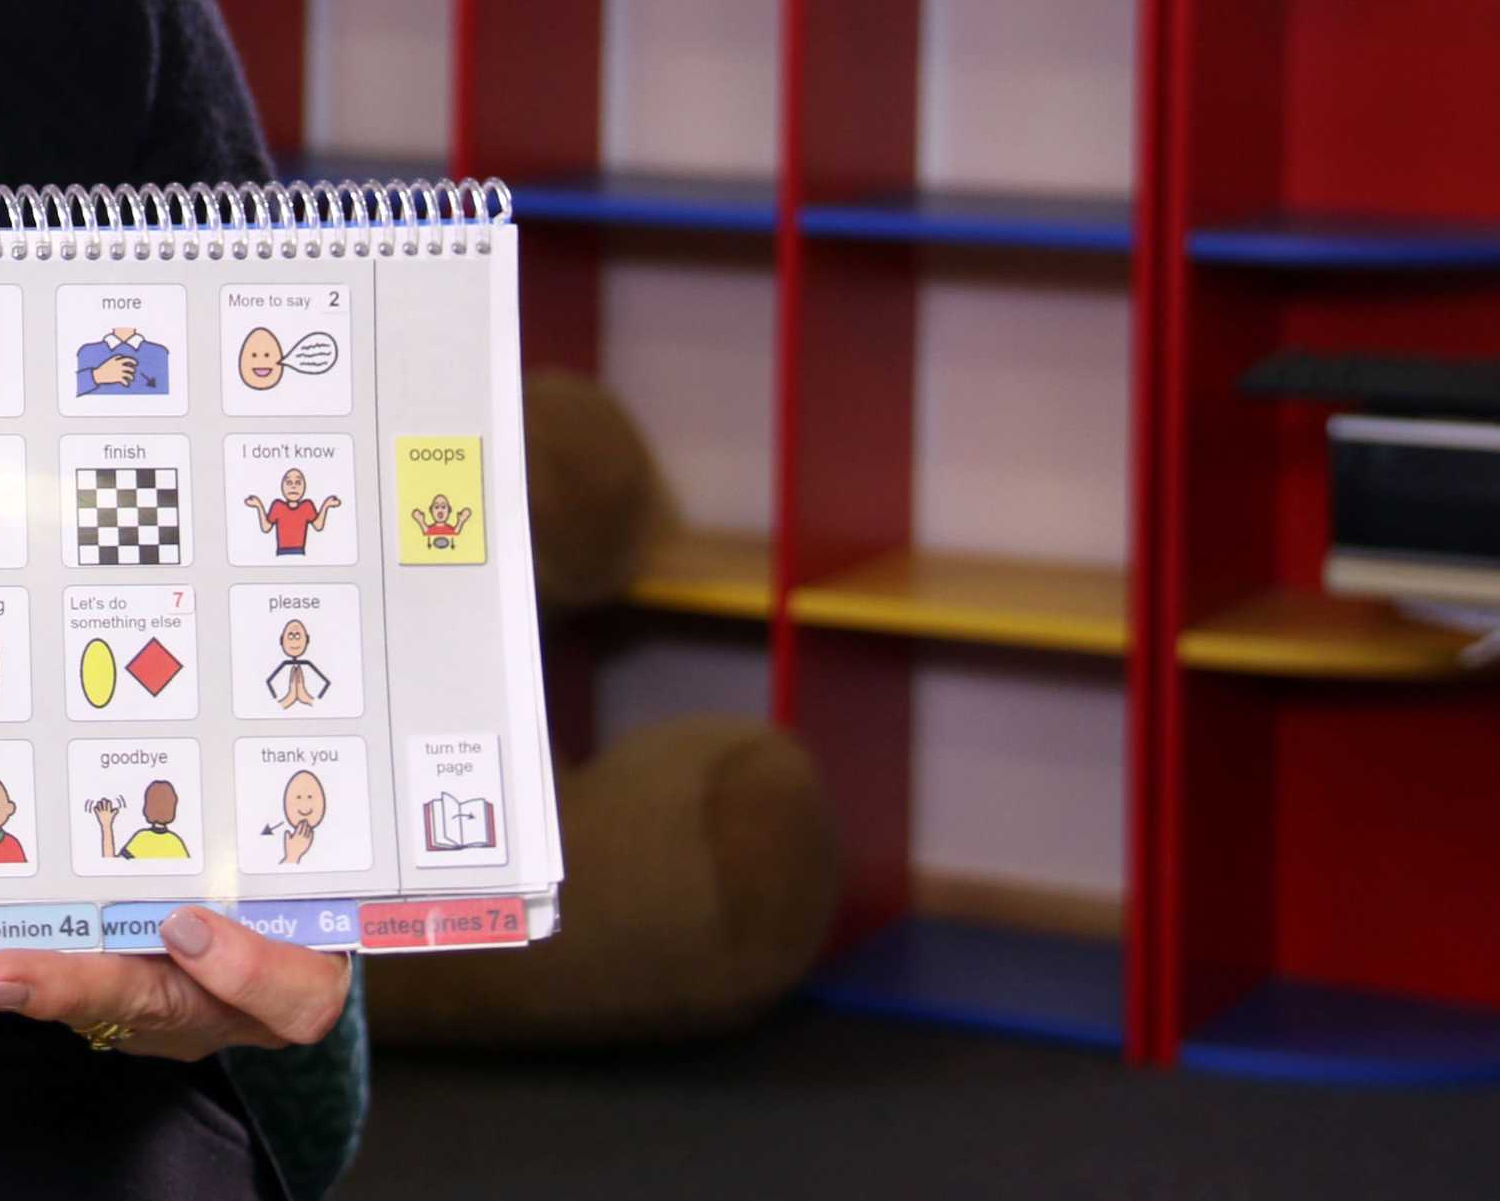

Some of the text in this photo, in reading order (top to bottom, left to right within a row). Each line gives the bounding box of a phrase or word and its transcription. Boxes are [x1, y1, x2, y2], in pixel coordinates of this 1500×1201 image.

[101, 297, 143, 311] more
[228, 293, 311, 310] More to say
[328, 291, 341, 307] 2
[103, 443, 147, 460] finish
[251, 443, 290, 459] don't
[293, 443, 336, 459] know
[408, 447, 466, 466] ooops
[70, 596, 128, 611] Let's do
[172, 592, 184, 607] 7
[268, 594, 321, 613] please
[70, 614, 182, 632] something else
[425, 741, 482, 755] turn the
[99, 748, 169, 770] goodbye
[261, 747, 339, 767] thank you
[436, 762, 474, 776] page
[57, 914, 91, 938] 4a
[318, 909, 352, 932] 6a
